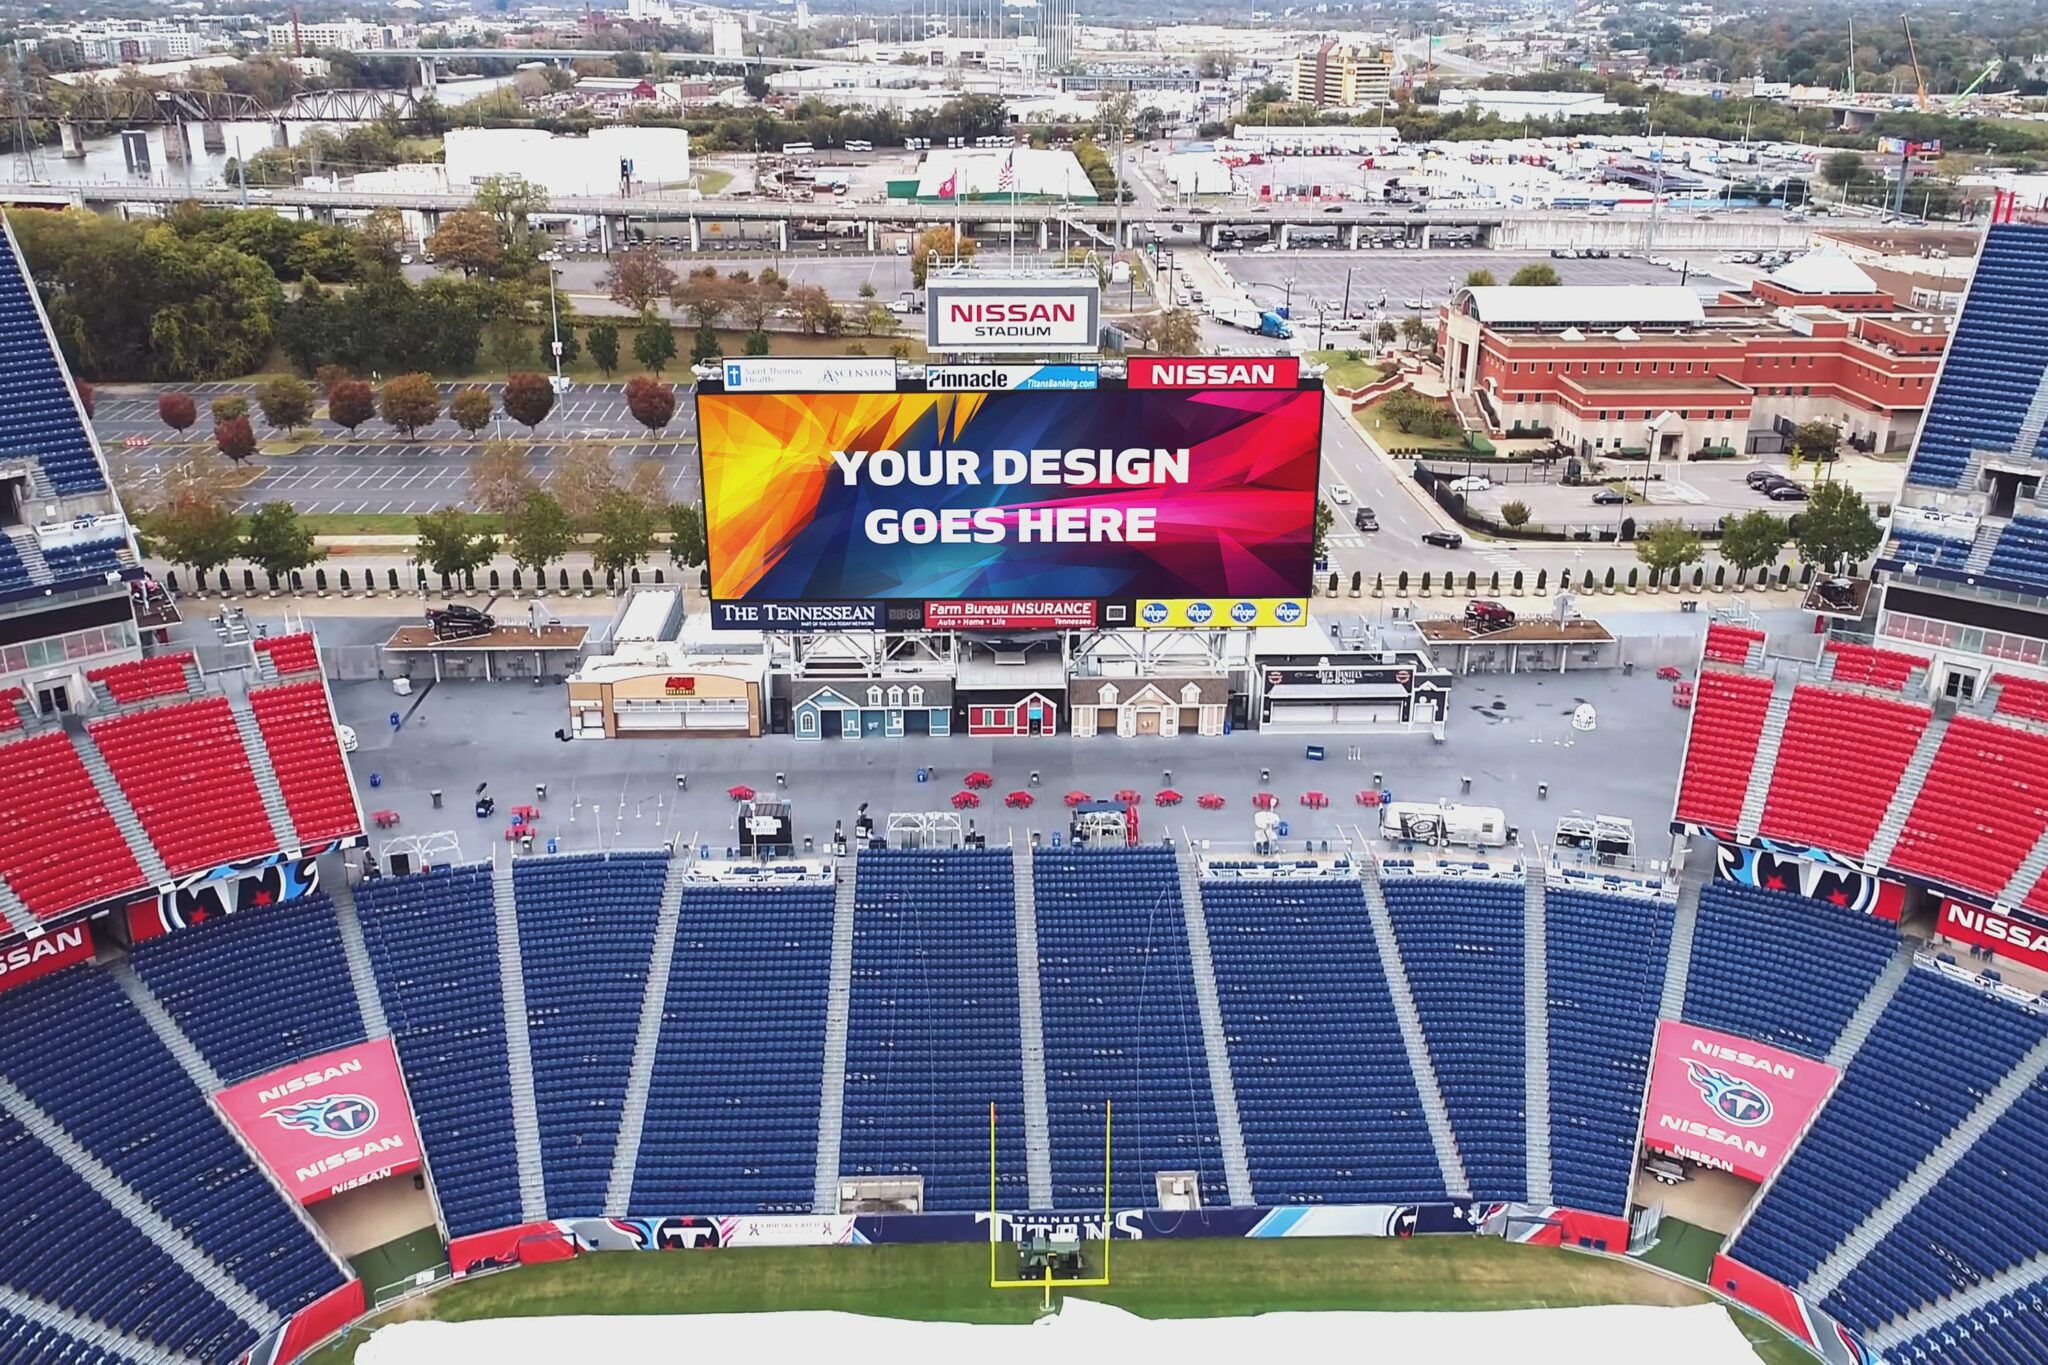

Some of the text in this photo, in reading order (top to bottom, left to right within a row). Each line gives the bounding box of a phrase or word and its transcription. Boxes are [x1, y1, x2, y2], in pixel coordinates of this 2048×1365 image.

[951, 303, 1075, 322] NISSAN
[974, 326, 1051, 337] STADIUM
[928, 370, 1008, 388] Pinnacle
[1151, 364, 1275, 385] NISSAN
[1027, 379, 1095, 389] TitansBanking.com
[829, 448, 1190, 487] YOUR DESIGN
[863, 507, 1157, 545] GOES HERE
[720, 603, 876, 621] THE TENNESSEAN
[929, 602, 1092, 615] Farm Bureau INSURANCE
[1142, 604, 1168, 621] Kroger
[1186, 604, 1212, 621] Kroger
[1230, 604, 1257, 621] Kroger
[1275, 604, 1301, 621] Kroger
[937, 618, 1006, 626] Auto Home Life
[1054, 617, 1092, 626] Tennessee
[1691, 1039, 1795, 1080] NISSAN
[257, 1058, 362, 1103] NISSAN
[1659, 1114, 1767, 1158] NISSAN
[295, 1134, 404, 1182] NISSAN
[1673, 1144, 1734, 1173] NISSAN
[331, 1167, 392, 1195] NISSAN
